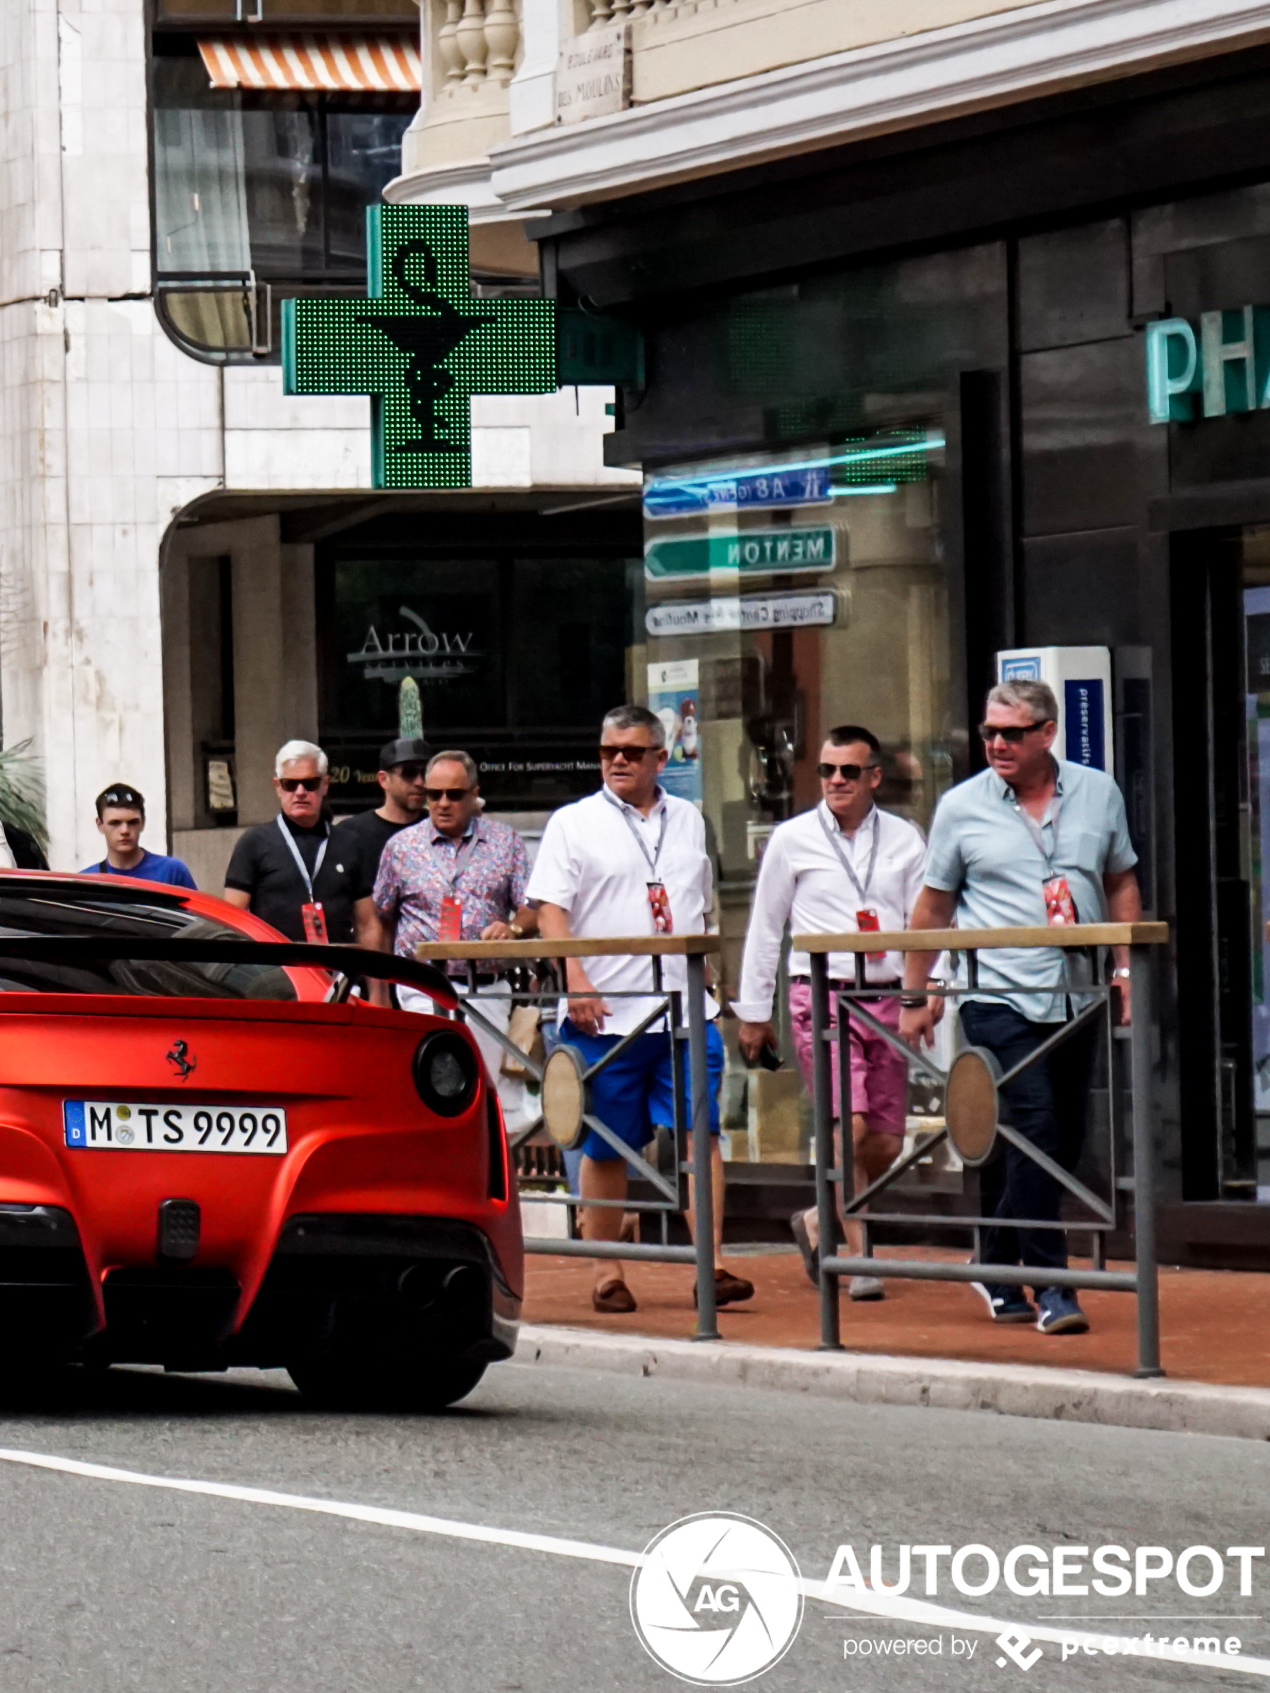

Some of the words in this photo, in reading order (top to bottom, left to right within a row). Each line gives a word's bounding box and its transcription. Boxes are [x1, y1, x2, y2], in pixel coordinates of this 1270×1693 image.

[360, 624, 474, 655] Arrow
[330, 766, 350, 784] 20
[72, 1128, 81, 1139] D
[89, 1106, 112, 1142] M
[138, 1108, 184, 1144] TS
[193, 1110, 281, 1148] 9999
